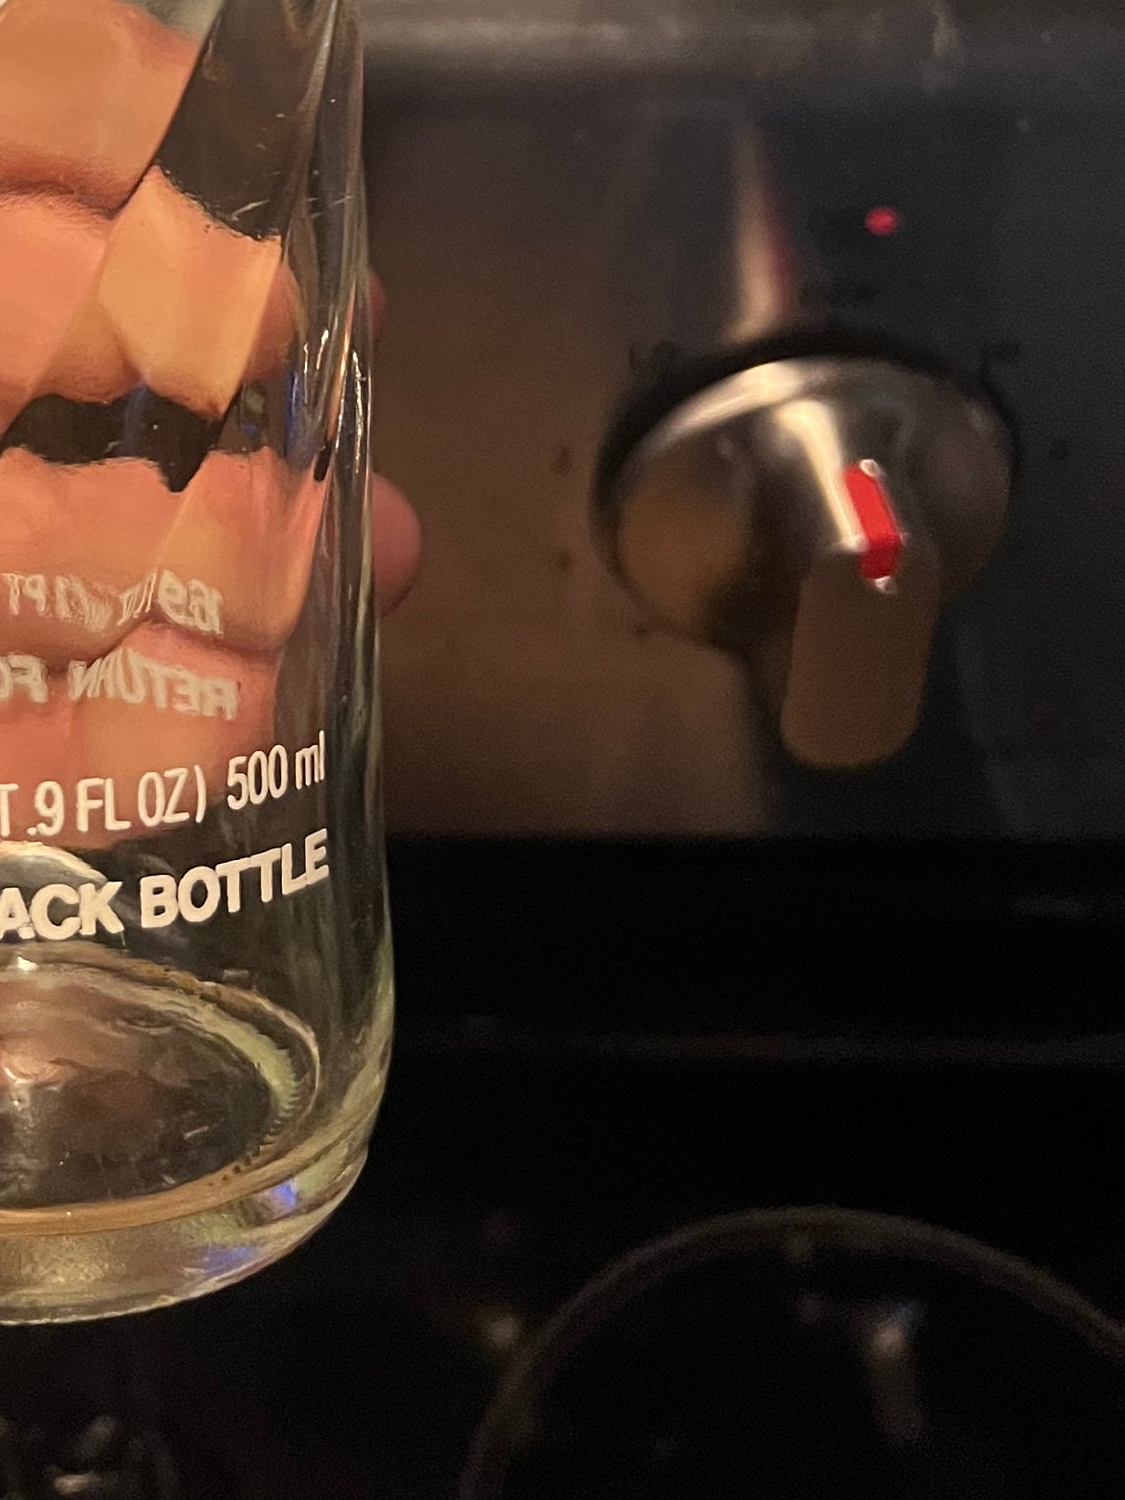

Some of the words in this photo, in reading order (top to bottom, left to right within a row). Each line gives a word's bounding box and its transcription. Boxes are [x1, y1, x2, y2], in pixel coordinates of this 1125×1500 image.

[76, 777, 131, 832] FL
[138, 764, 207, 827] OZ)
[227, 744, 288, 810] 500
[295, 730, 325, 790] ml
[140, 828, 329, 929] BOTTLE
